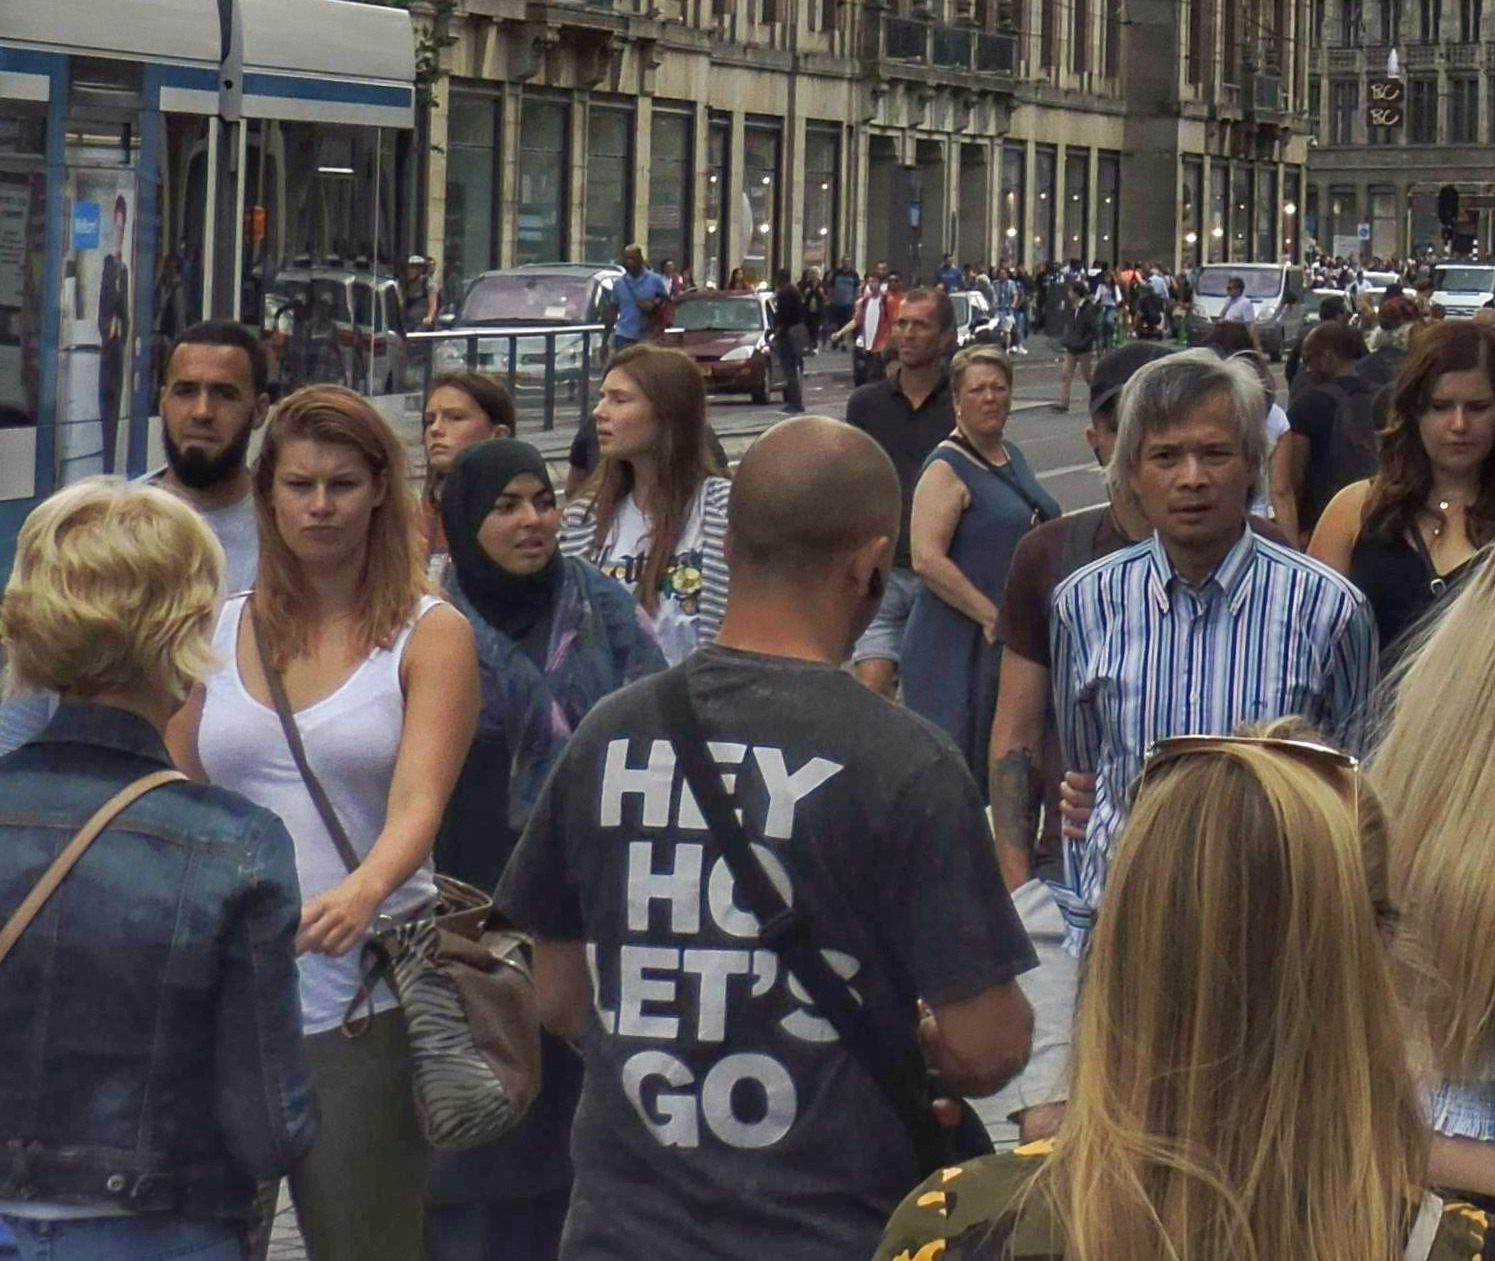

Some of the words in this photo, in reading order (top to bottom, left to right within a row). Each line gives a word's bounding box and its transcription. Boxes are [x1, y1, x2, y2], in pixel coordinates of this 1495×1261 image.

[600, 737, 845, 841] HEY
[627, 841, 795, 940] HO
[586, 942, 864, 1044] LET'S
[621, 1049, 799, 1150] GO
